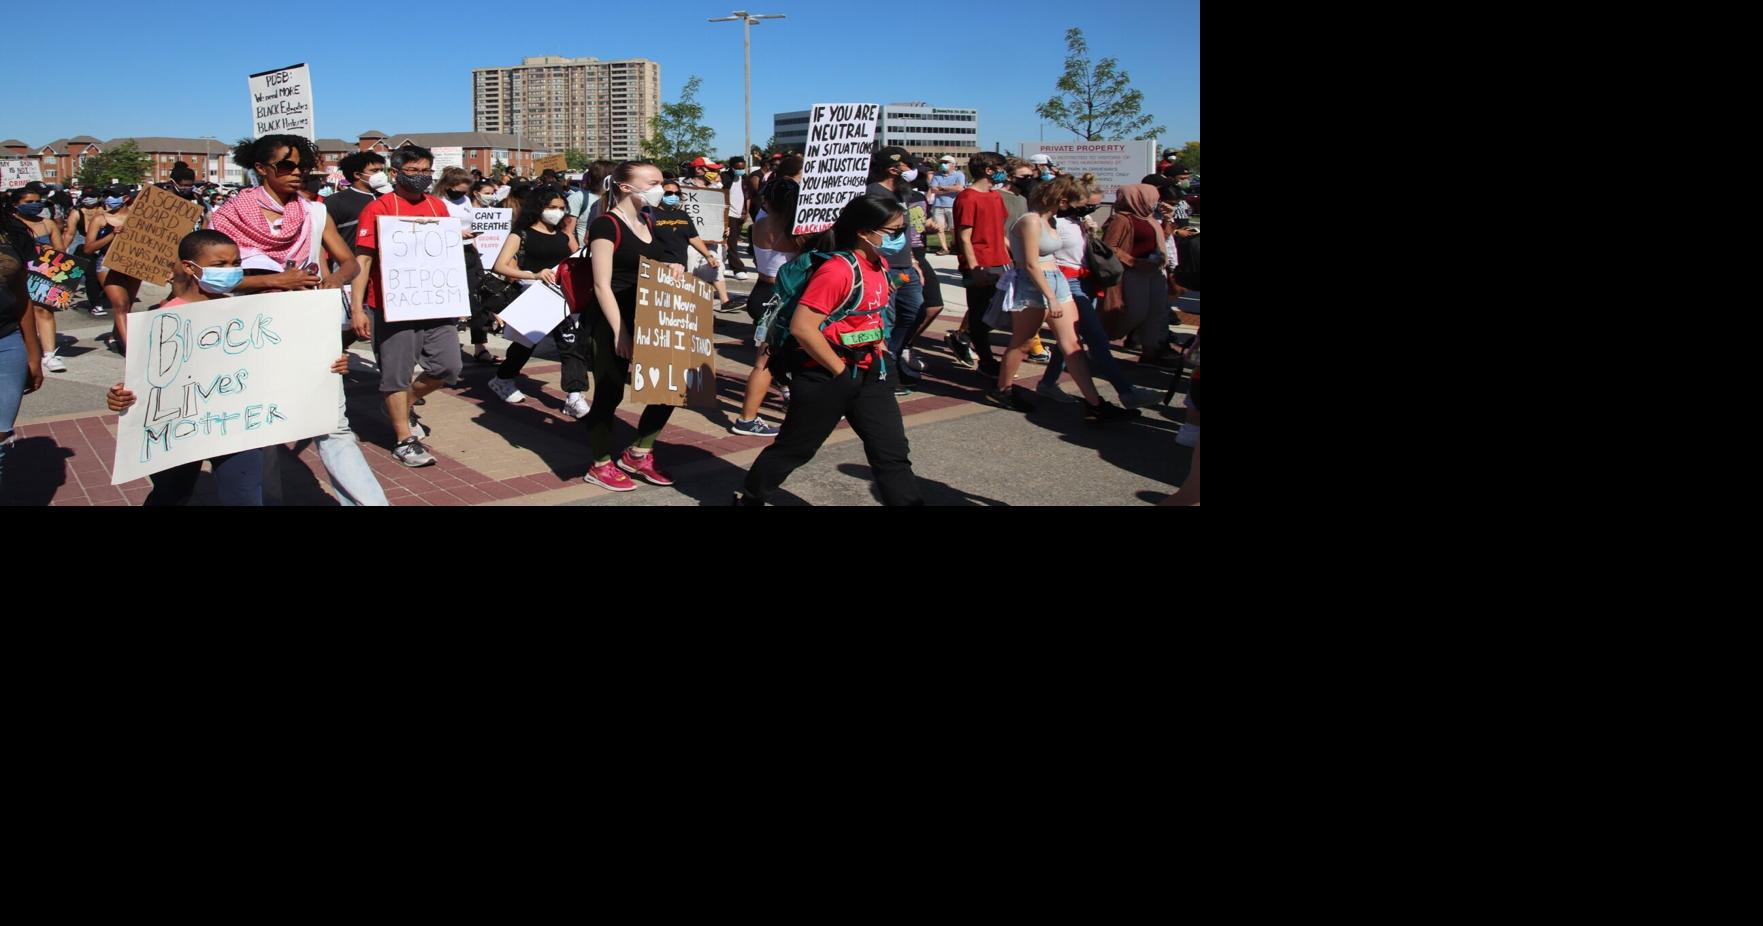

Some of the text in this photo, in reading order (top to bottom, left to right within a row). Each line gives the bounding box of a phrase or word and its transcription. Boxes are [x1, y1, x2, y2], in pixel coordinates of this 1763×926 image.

[279, 84, 301, 97] MORE
[256, 104, 280, 119] BLACK
[813, 104, 877, 123] IF YOU ARE
[257, 119, 281, 134] BLACK
[811, 123, 868, 142] NEUTRAL
[807, 141, 874, 157] IN SITUATIONS
[1076, 144, 1125, 152] PROPERTY
[804, 157, 869, 174] OF INJUSTICE
[802, 175, 868, 191] YOU HAVE CHOSEN
[140, 187, 199, 223] A SCHOOL
[798, 193, 813, 207] THE
[814, 192, 835, 206] SIDE
[835, 191, 849, 204] OF
[133, 201, 179, 228] BOARD
[475, 211, 502, 220] CAN'T
[796, 207, 842, 224] OPPRES
[127, 217, 168, 239] CANNOT
[471, 222, 509, 231] BREATHE
[115, 241, 127, 252] IT
[129, 244, 151, 261] WAS
[120, 229, 174, 258] STUDENTS
[392, 229, 461, 258] STOP
[111, 252, 161, 275] DESIGNED
[640, 262, 651, 279] I
[125, 267, 155, 281] TEACH
[388, 267, 459, 290] BIPOC
[386, 288, 462, 308] RACISM
[639, 287, 697, 313] I Will Never
[658, 310, 698, 332] Understand
[636, 326, 651, 346] And
[652, 328, 671, 348] Still
[674, 330, 686, 351] I
